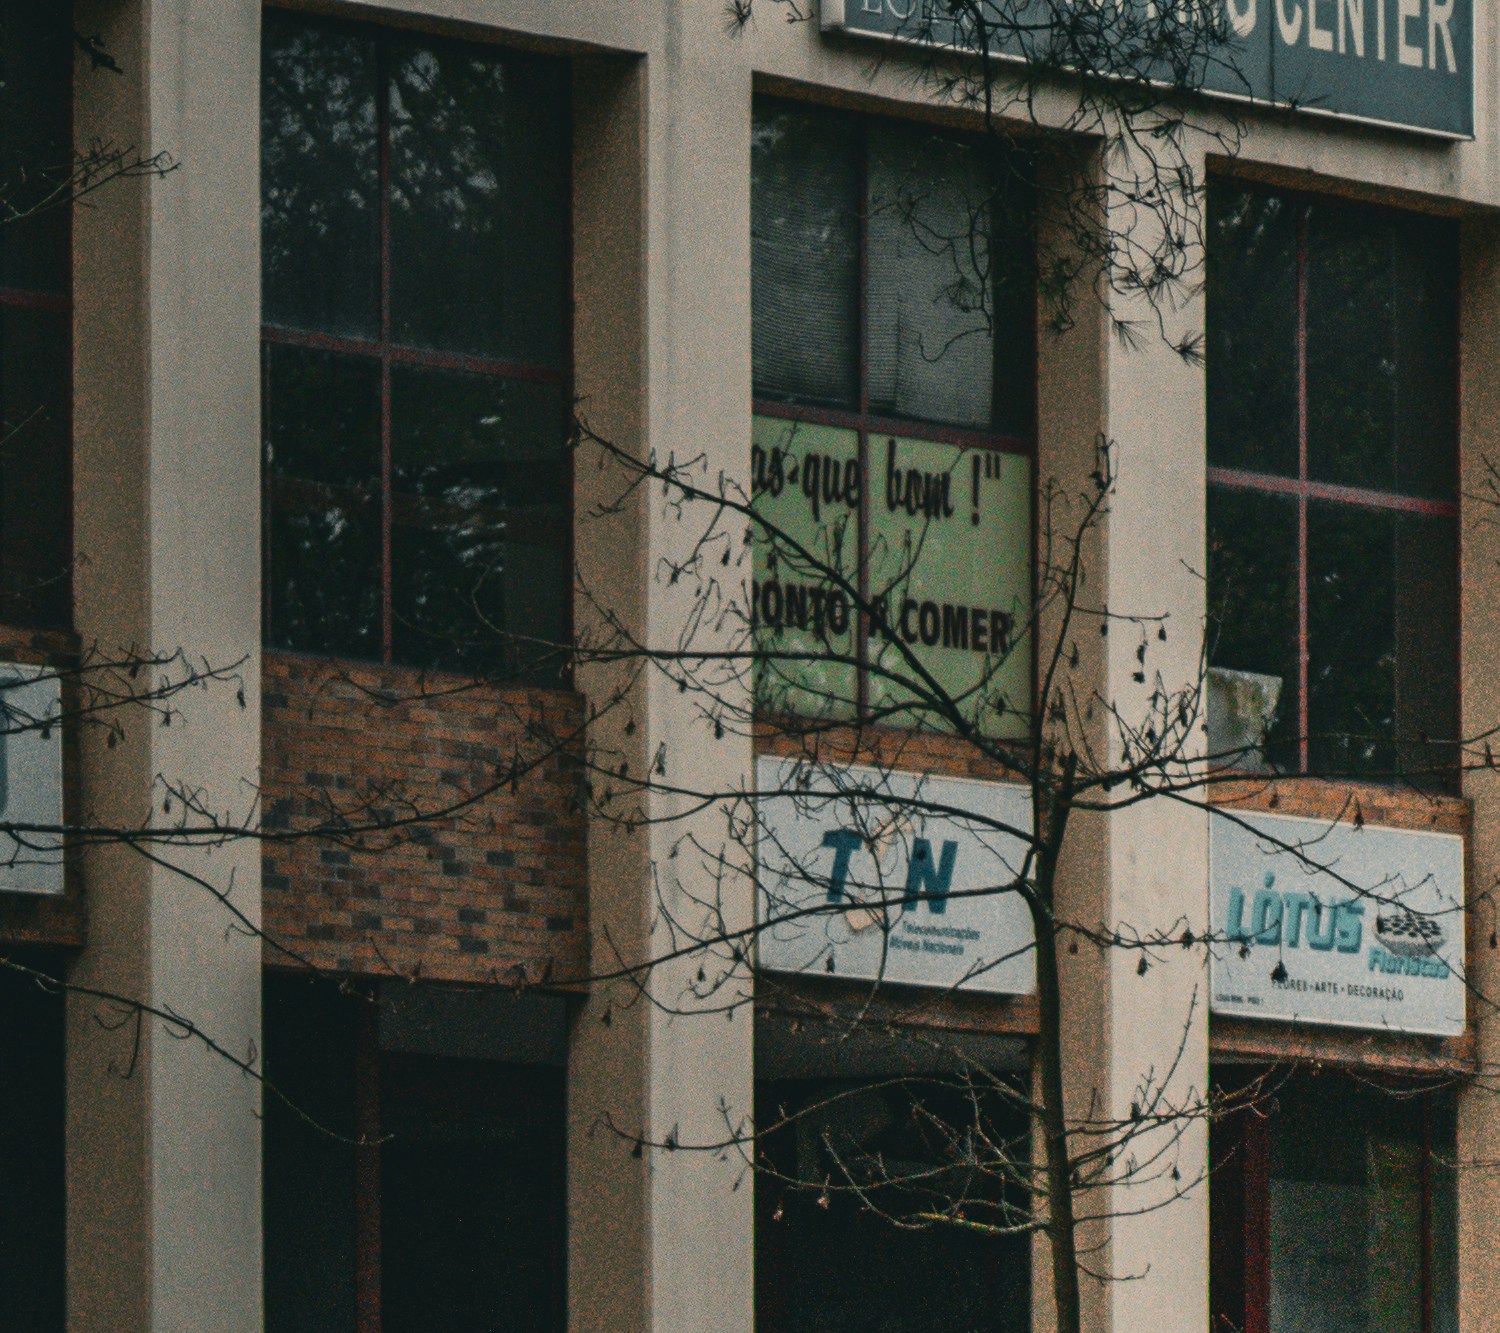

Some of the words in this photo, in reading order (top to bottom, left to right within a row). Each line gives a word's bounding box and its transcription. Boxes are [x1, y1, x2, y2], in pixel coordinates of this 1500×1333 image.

[886, 438, 954, 520] bom
[902, 598, 1011, 654] COMER
[1226, 870, 1365, 954] LÓTUS
[1313, 982, 1339, 997] ARTE
[1347, 985, 1404, 1003] DECORAÇÃO
